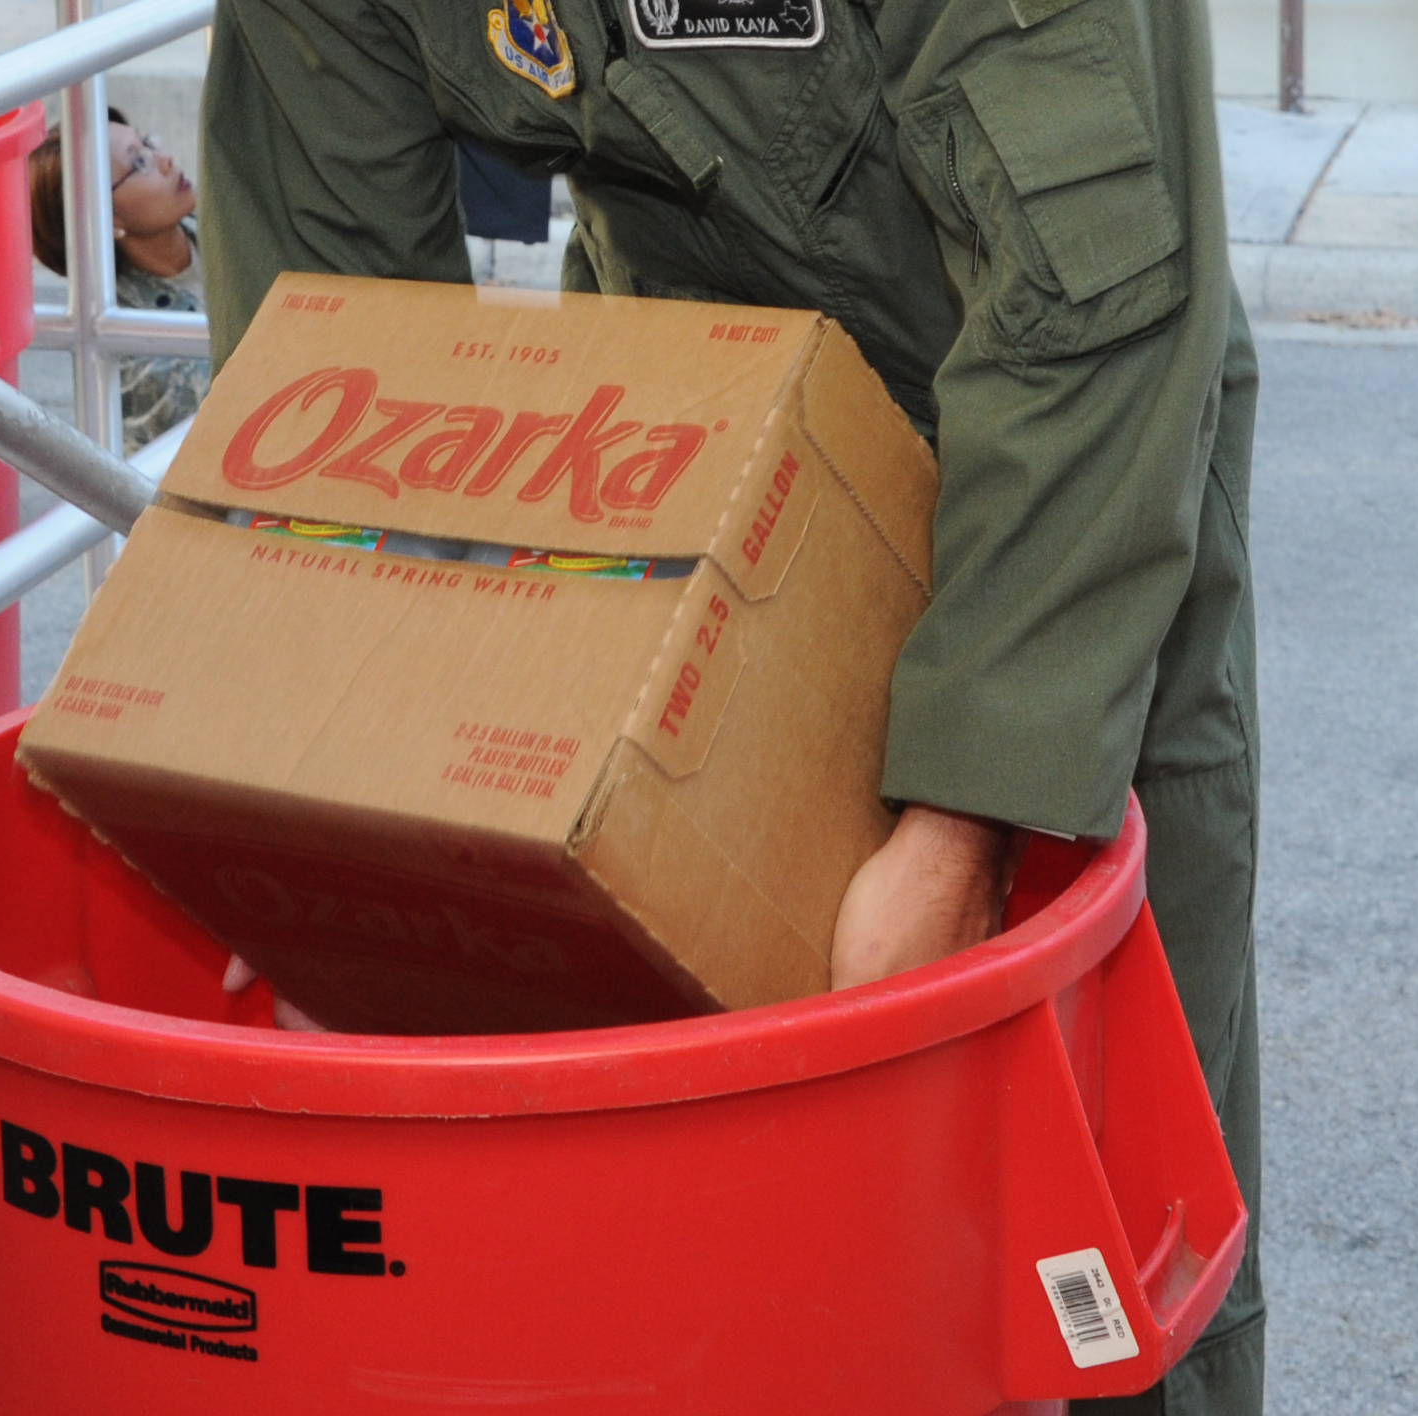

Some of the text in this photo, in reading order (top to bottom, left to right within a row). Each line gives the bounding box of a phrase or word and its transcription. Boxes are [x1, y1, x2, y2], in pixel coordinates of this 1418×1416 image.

[684, 17, 780, 34] DAVID KAYA
[504, 45, 524, 69] US
[529, 62, 550, 84] AIR
[282, 293, 345, 313] THIS SIDE UP
[708, 324, 780, 343] DO NOT CUT!
[452, 341, 561, 364] EST. 1905
[221, 365, 709, 523] Ozarka
[608, 515, 653, 530] BRAND
[250, 544, 557, 601] NATURAL SPRING WATER
[657, 450, 801, 738] TWO 2.5 GALLON
[488, 727, 539, 749] GALLON
[467, 745, 517, 769] PLASTIC
[520, 776, 557, 798] TOTAL
[0, 1118, 387, 1277] BRUTE
[105, 1271, 249, 1321] Rubbermaid
[1112, 1318, 1126, 1339] RED
[190, 1334, 259, 1363] Products
